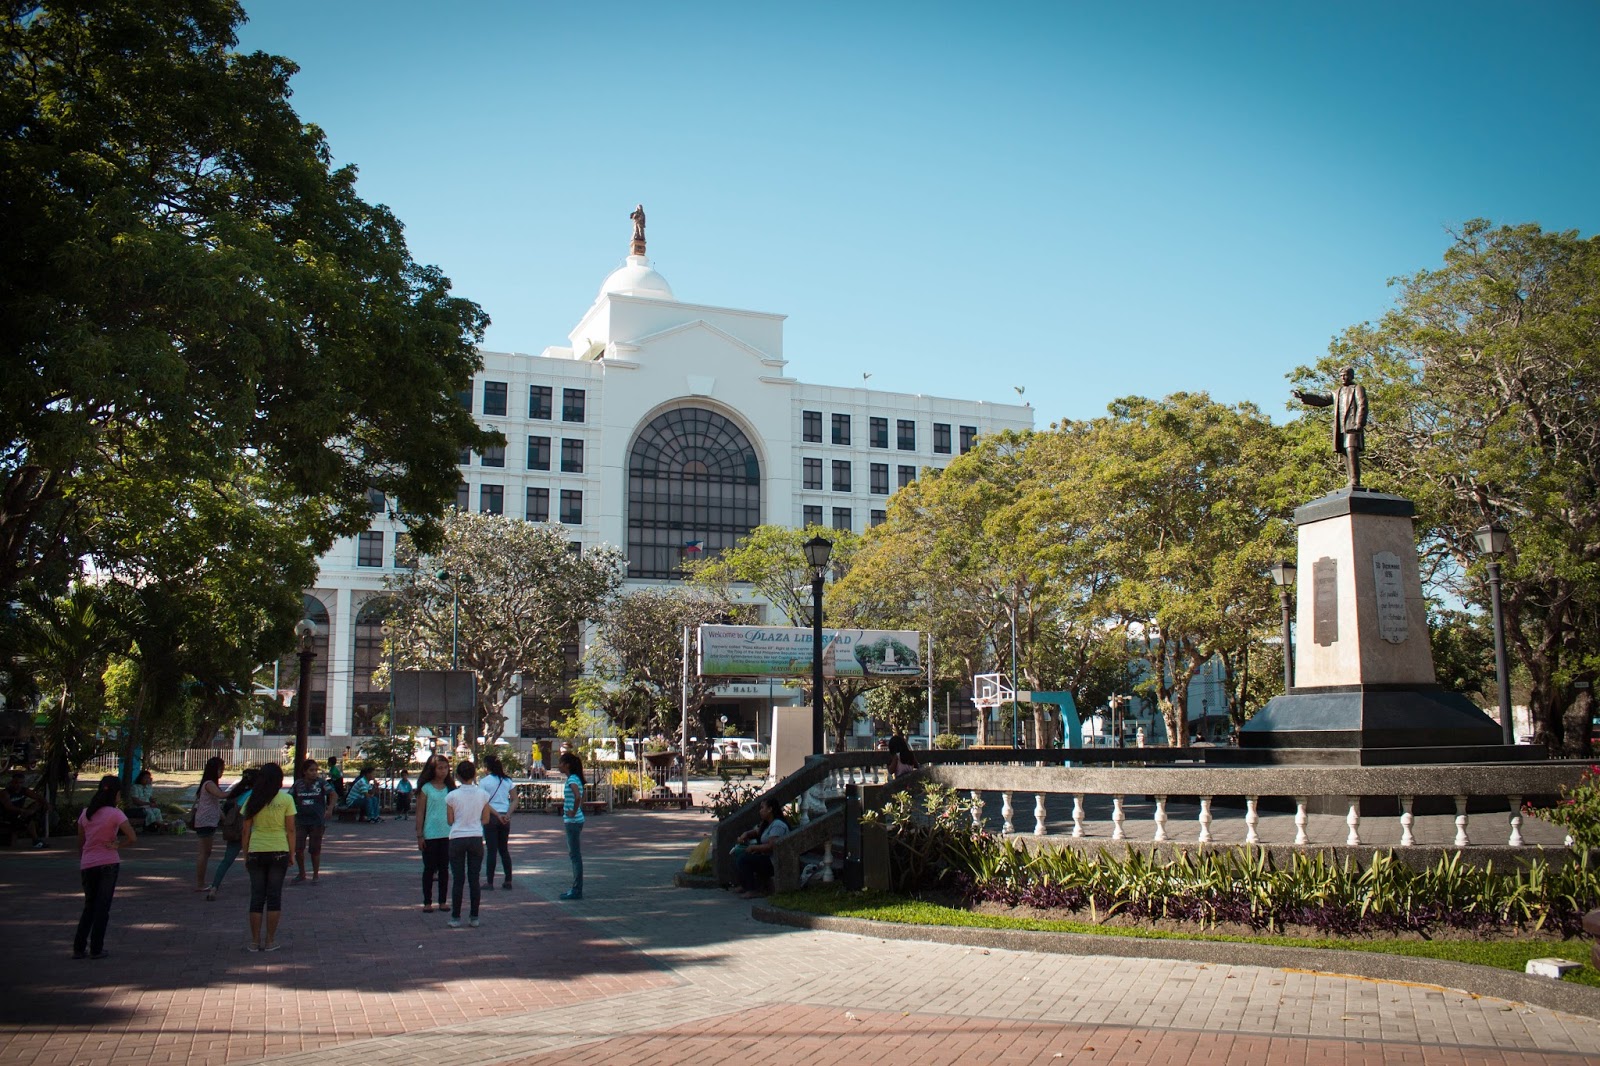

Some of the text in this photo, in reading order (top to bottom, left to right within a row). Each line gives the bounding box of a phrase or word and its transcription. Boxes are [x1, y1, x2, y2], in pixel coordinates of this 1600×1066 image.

[708, 631, 736, 639] Welcome
[744, 630, 790, 644] PLAZA
[794, 634, 852, 644] LIBRTAD
